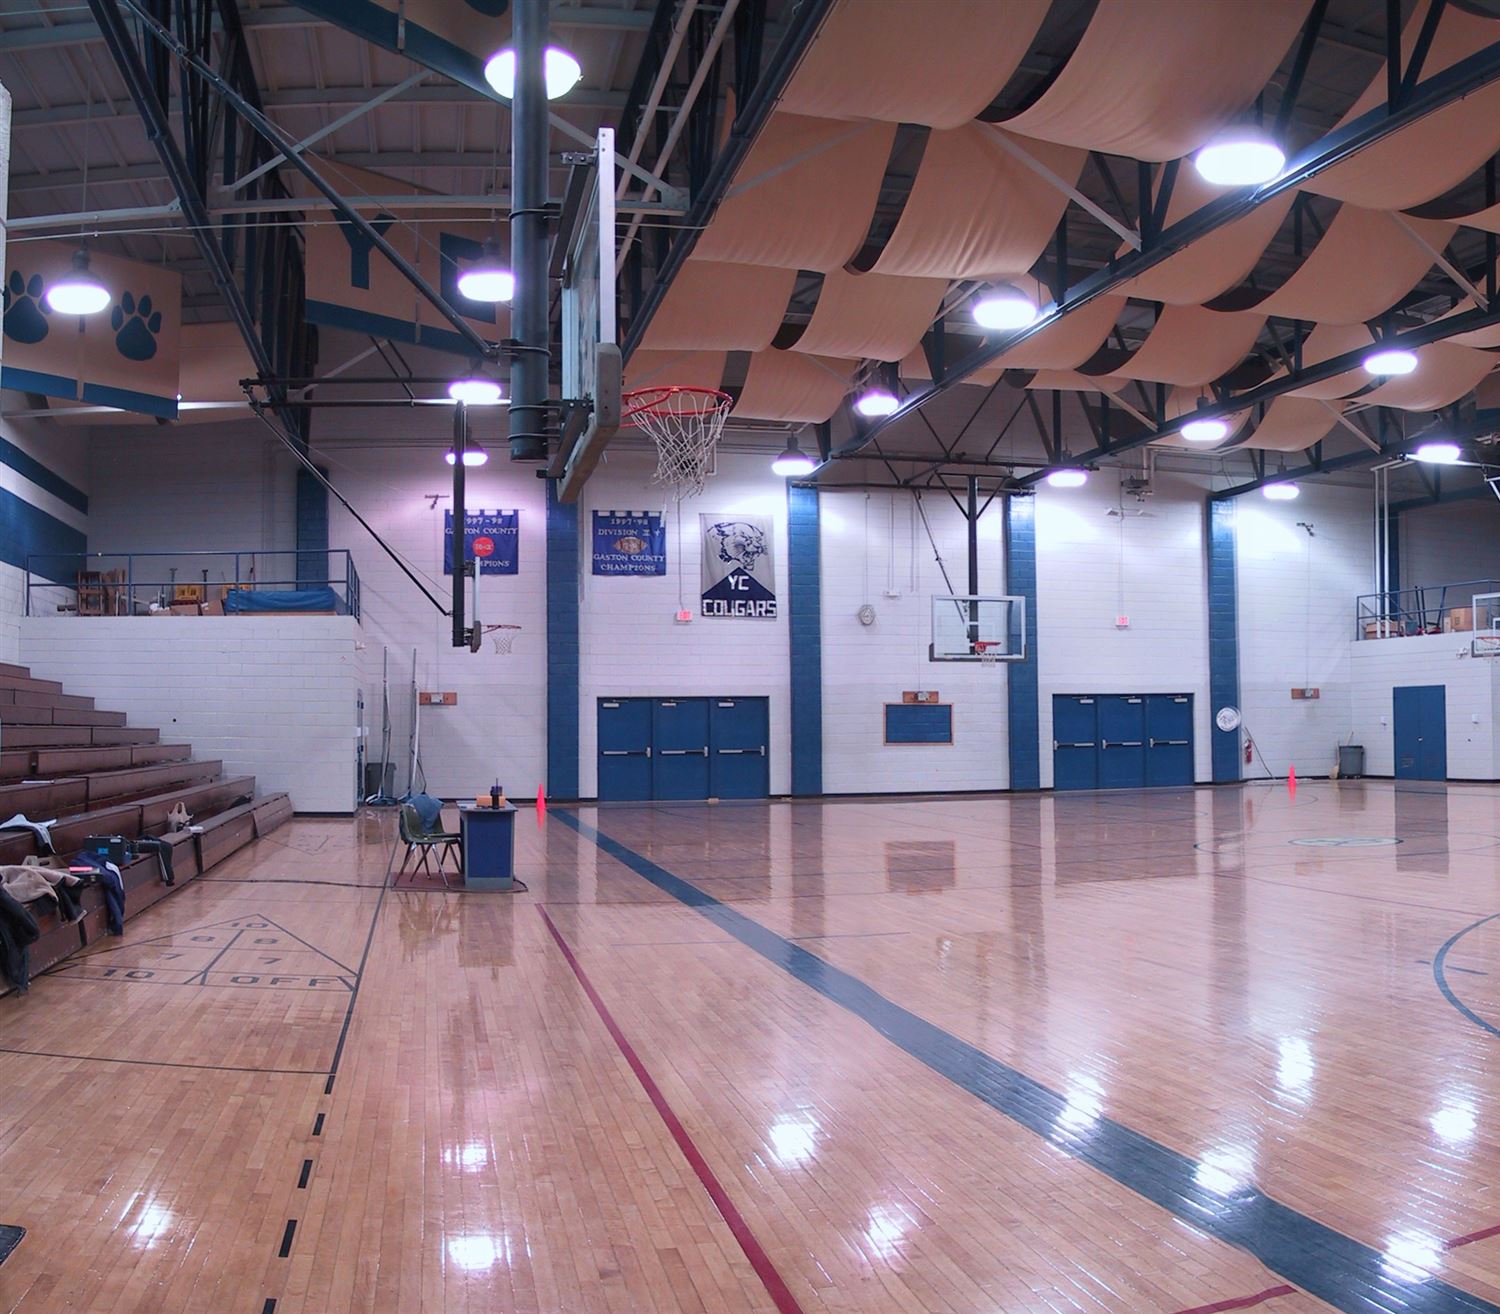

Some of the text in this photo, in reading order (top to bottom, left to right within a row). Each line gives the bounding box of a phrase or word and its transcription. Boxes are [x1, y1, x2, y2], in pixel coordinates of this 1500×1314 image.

[463, 517, 503, 525] 997-98
[445, 527, 518, 535] GTON COUNTY
[598, 528, 638, 536] DIVISION
[630, 554, 665, 562] COUNTY
[600, 563, 656, 572] CHAMPIONS
[728, 575, 750, 590] YC
[702, 599, 777, 617] COUGARS
[258, 956, 283, 965] 7
[103, 969, 339, 987] 10 OFF
